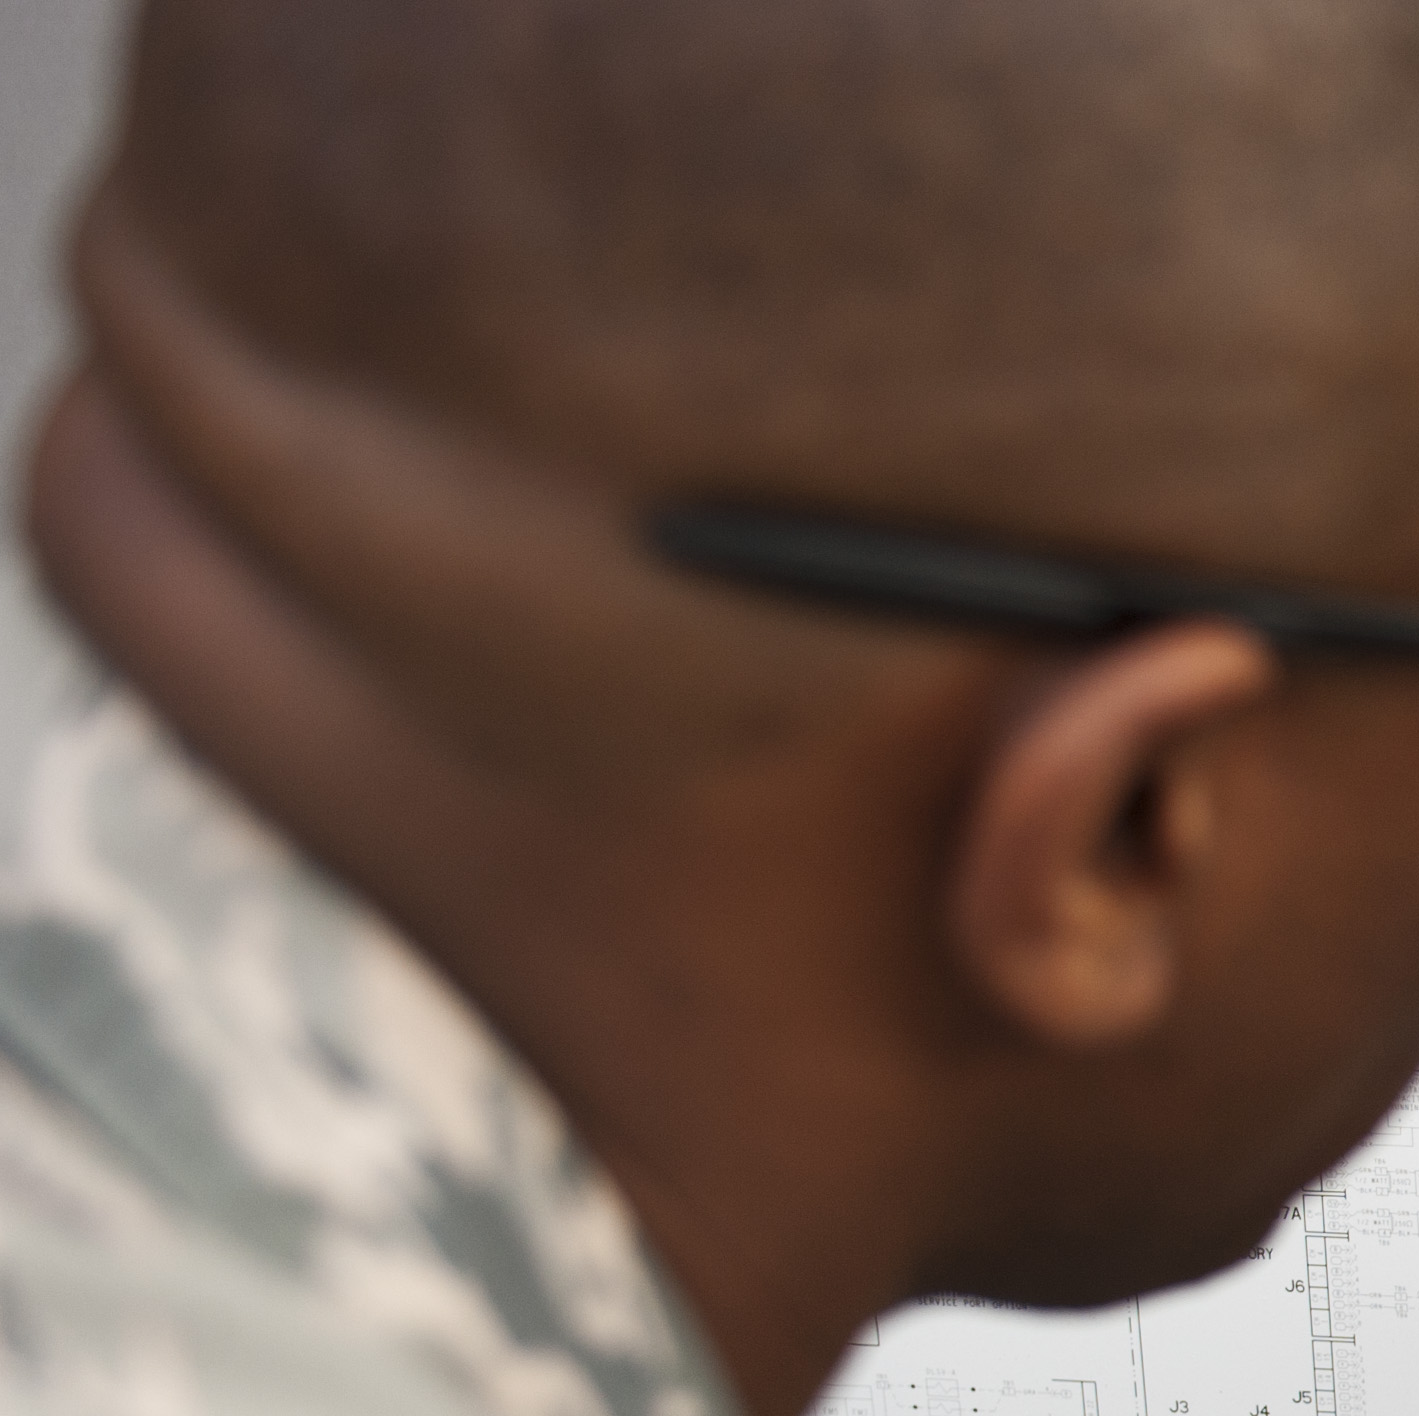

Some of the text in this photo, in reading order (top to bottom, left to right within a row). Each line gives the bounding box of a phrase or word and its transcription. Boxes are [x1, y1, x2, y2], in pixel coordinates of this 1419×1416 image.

[1285, 1280, 1305, 1293] J6
[1292, 1390, 1312, 1404] J5
[1169, 1400, 1189, 1414] J3
